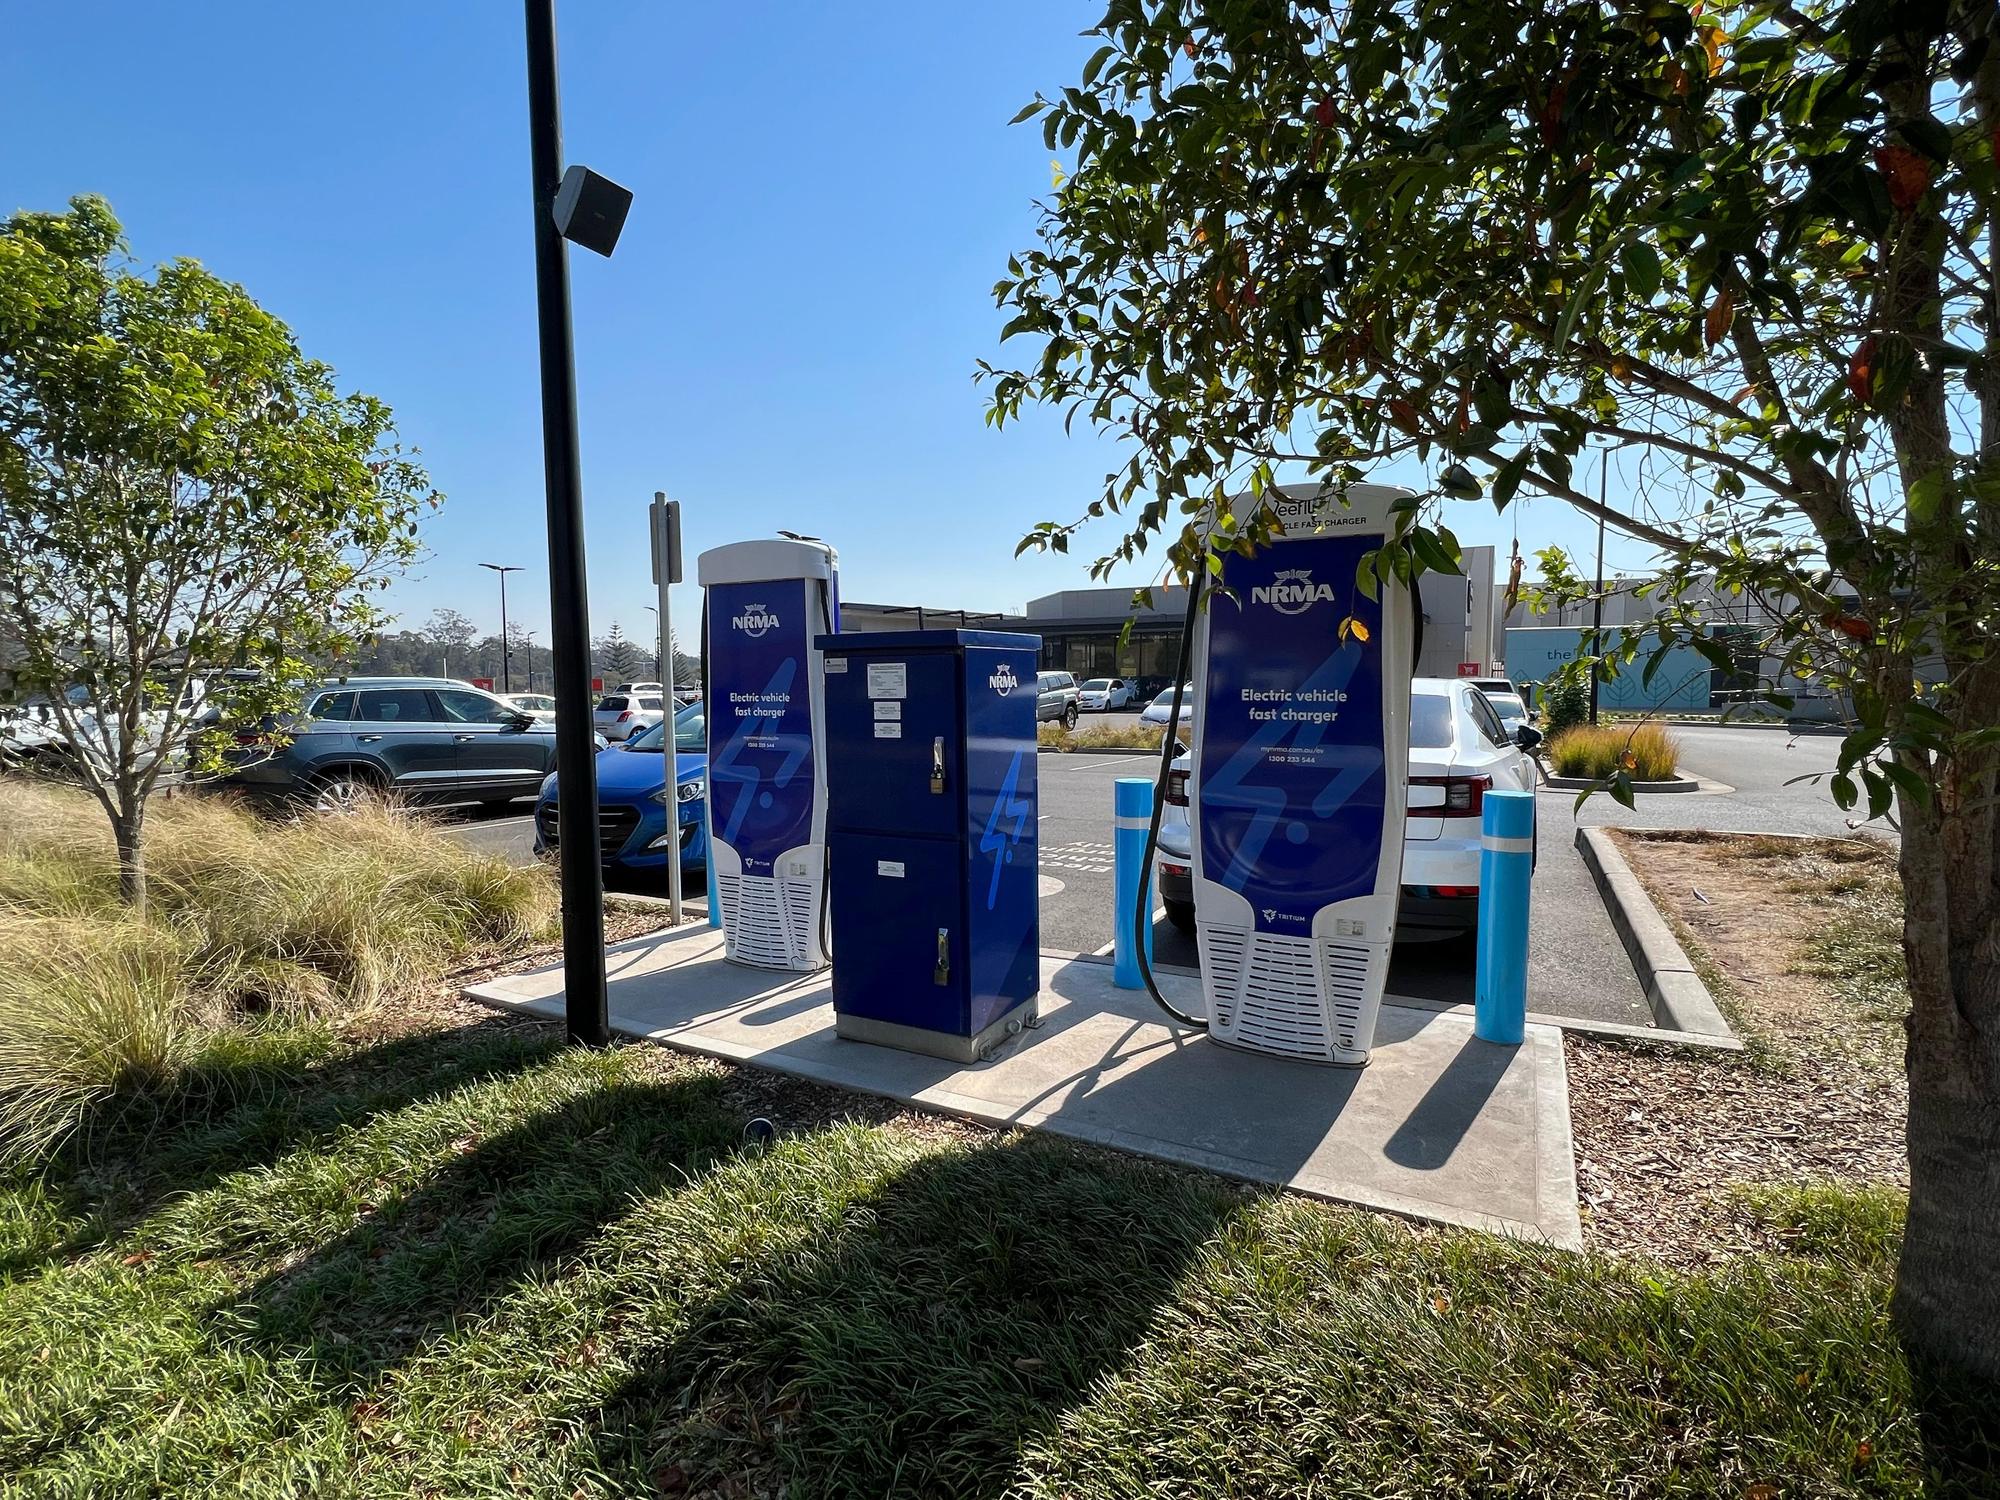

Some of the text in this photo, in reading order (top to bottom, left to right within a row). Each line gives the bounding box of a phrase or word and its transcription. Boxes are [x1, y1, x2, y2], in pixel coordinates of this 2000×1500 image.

[1324, 517, 1367, 527] CHARGER
[1252, 584, 1335, 604] NRMA
[732, 615, 780, 629] NRMA
[1548, 650, 1571, 660] the
[989, 675, 1018, 689] NRMA
[729, 692, 790, 702] Electric vehicle
[1241, 688, 1348, 702] Electric vehicle
[735, 706, 786, 719] fast charger
[1249, 707, 1338, 724] fast charger
[1268, 755, 1286, 763] 1300
[1278, 913, 1306, 922] TRITIUM
